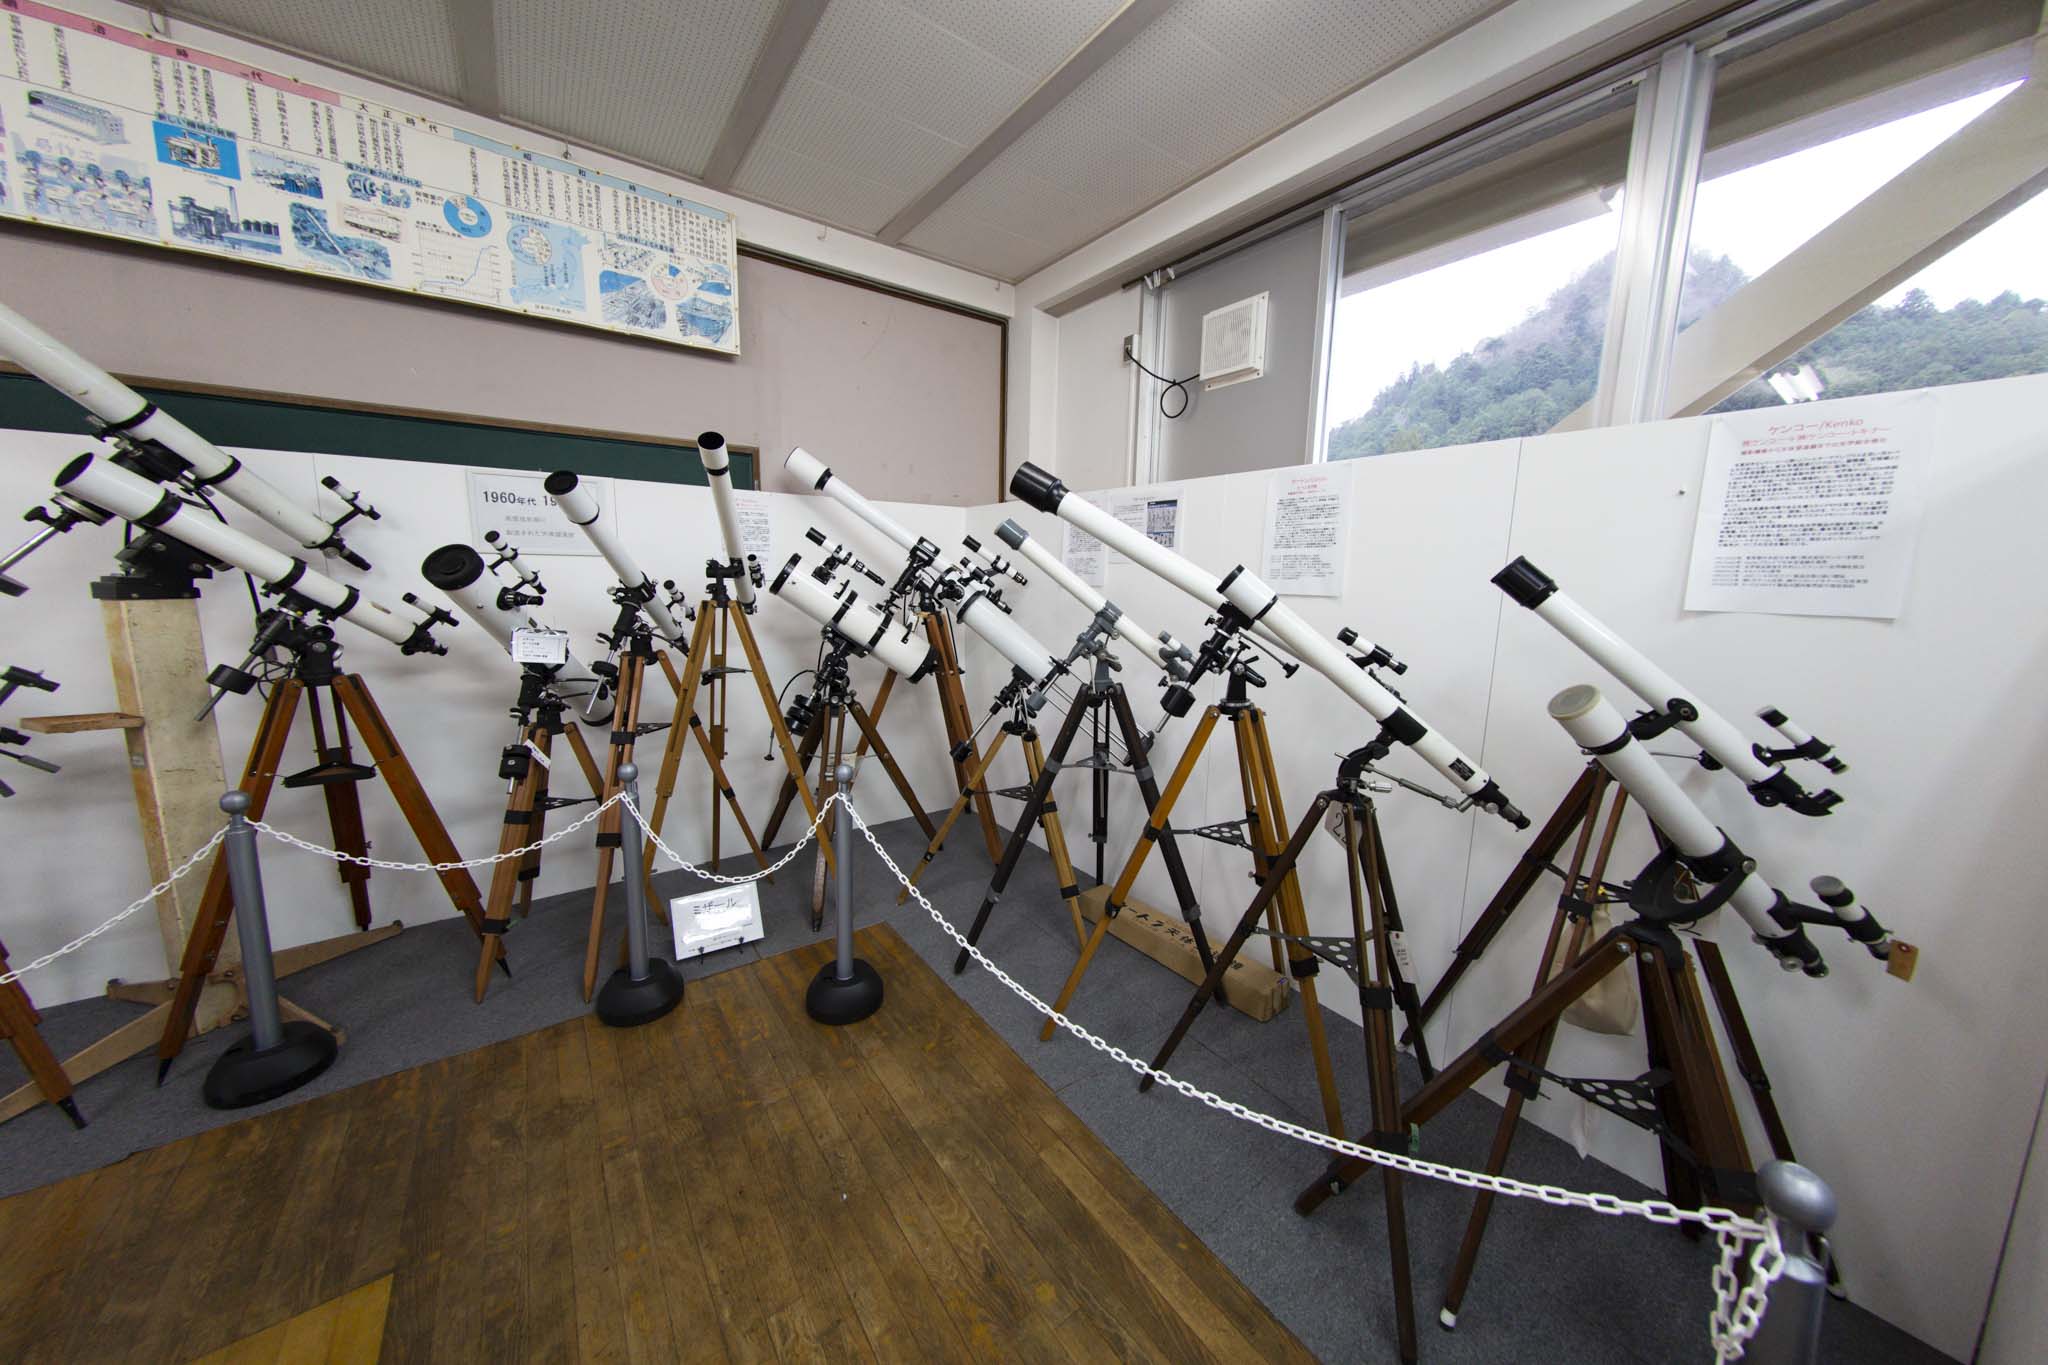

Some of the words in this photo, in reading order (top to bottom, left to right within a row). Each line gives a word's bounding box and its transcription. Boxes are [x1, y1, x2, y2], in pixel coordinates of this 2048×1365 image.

[359, 103, 438, 133] 大正時代
[523, 153, 684, 206] 昭和時代
[483, 491, 537, 506] 1960年代
[693, 897, 736, 914] ミザール
